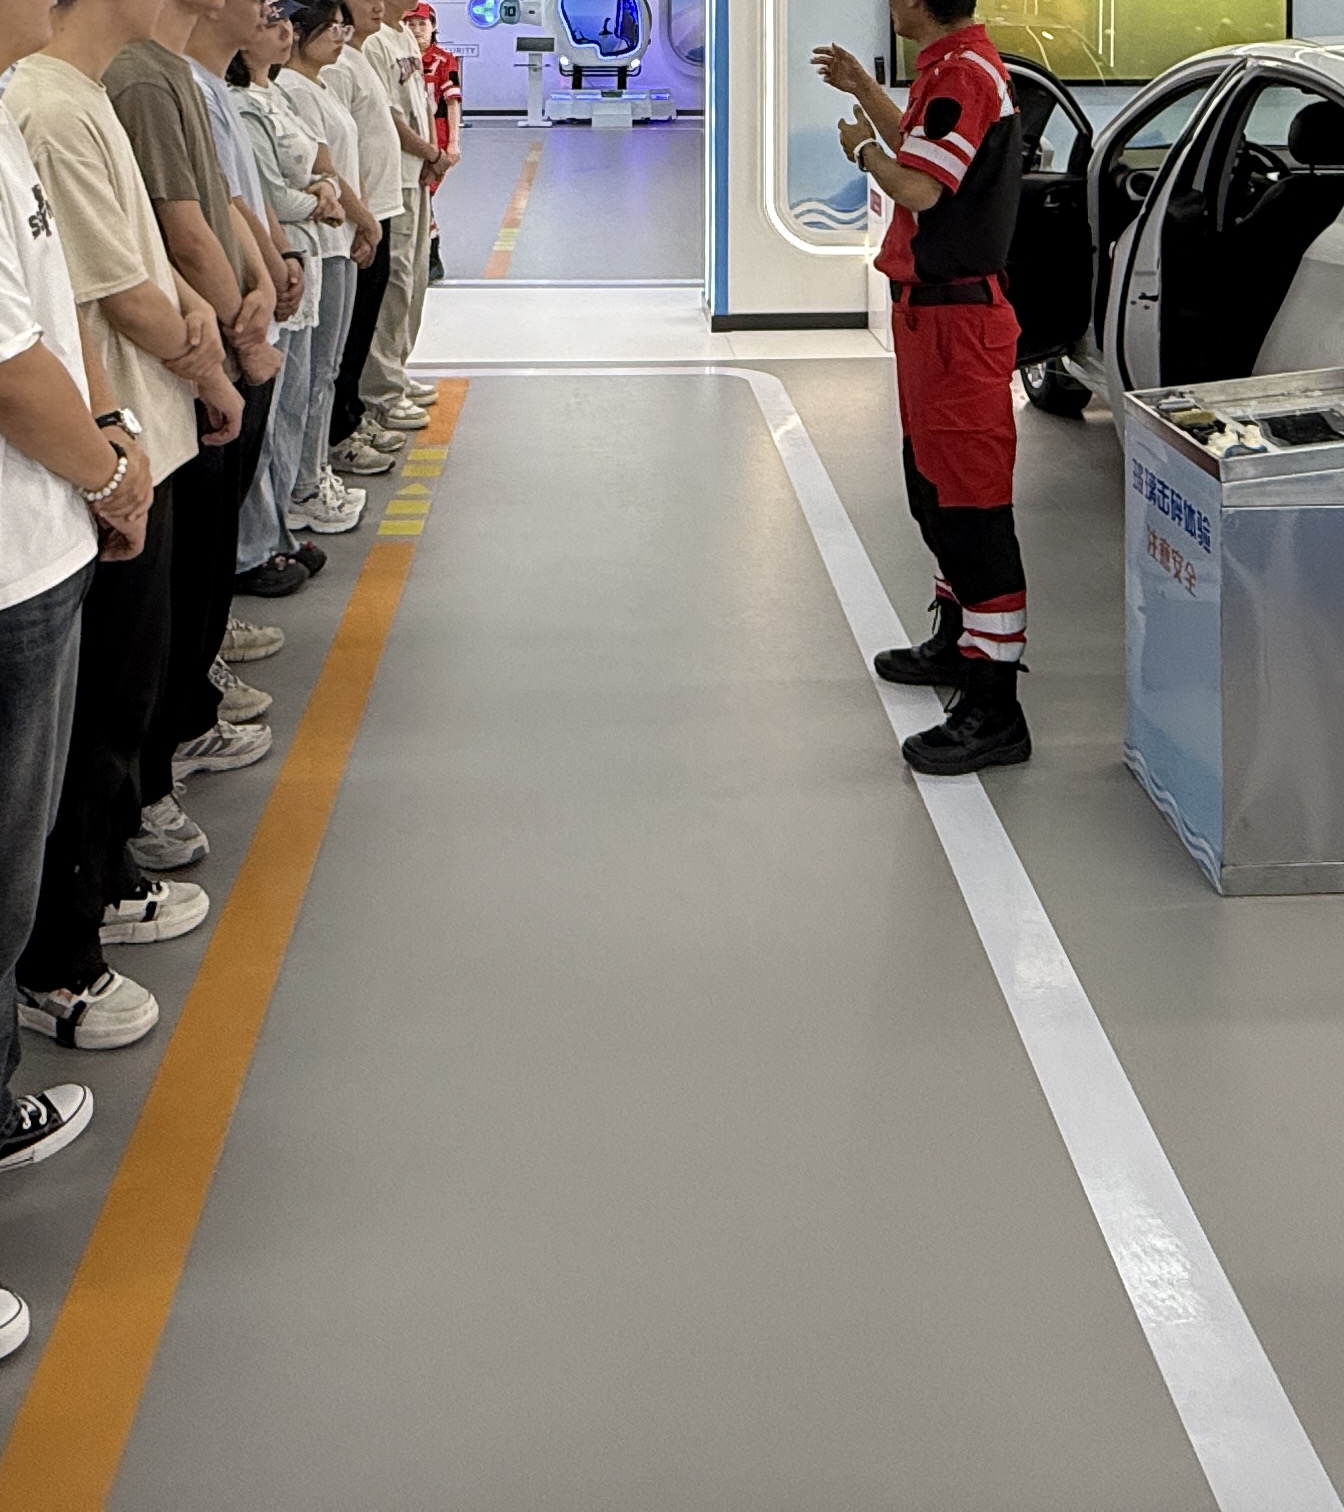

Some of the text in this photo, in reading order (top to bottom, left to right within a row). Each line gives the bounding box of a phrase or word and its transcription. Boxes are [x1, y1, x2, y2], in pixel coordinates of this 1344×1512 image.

[503, 5, 516, 17] 10
[1145, 524, 1199, 599] 注意安全
